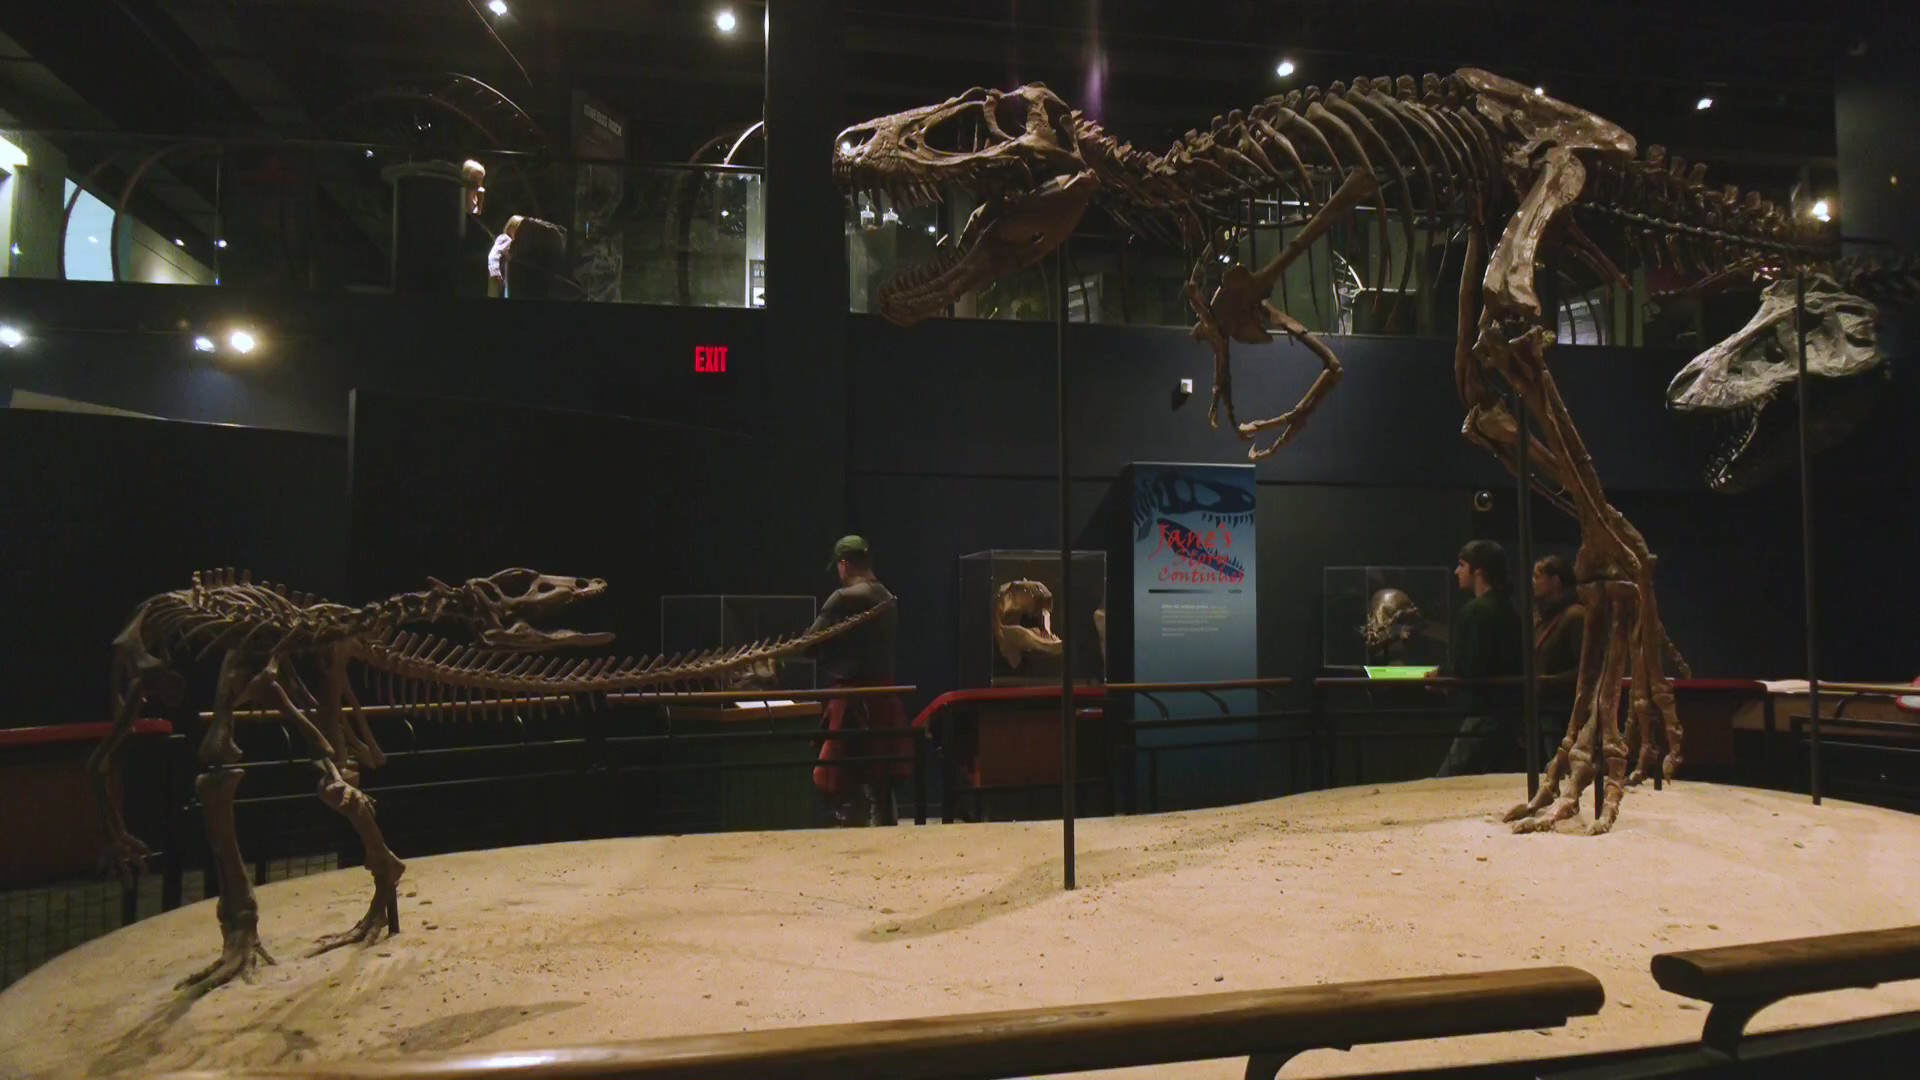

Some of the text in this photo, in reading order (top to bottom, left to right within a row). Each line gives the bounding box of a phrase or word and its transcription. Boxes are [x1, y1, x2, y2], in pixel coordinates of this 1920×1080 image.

[695, 346, 728, 372] EXIT
[1149, 522, 1232, 560] Jane's
[1173, 550, 1229, 572] Story
[1158, 567, 1244, 584] Continues
